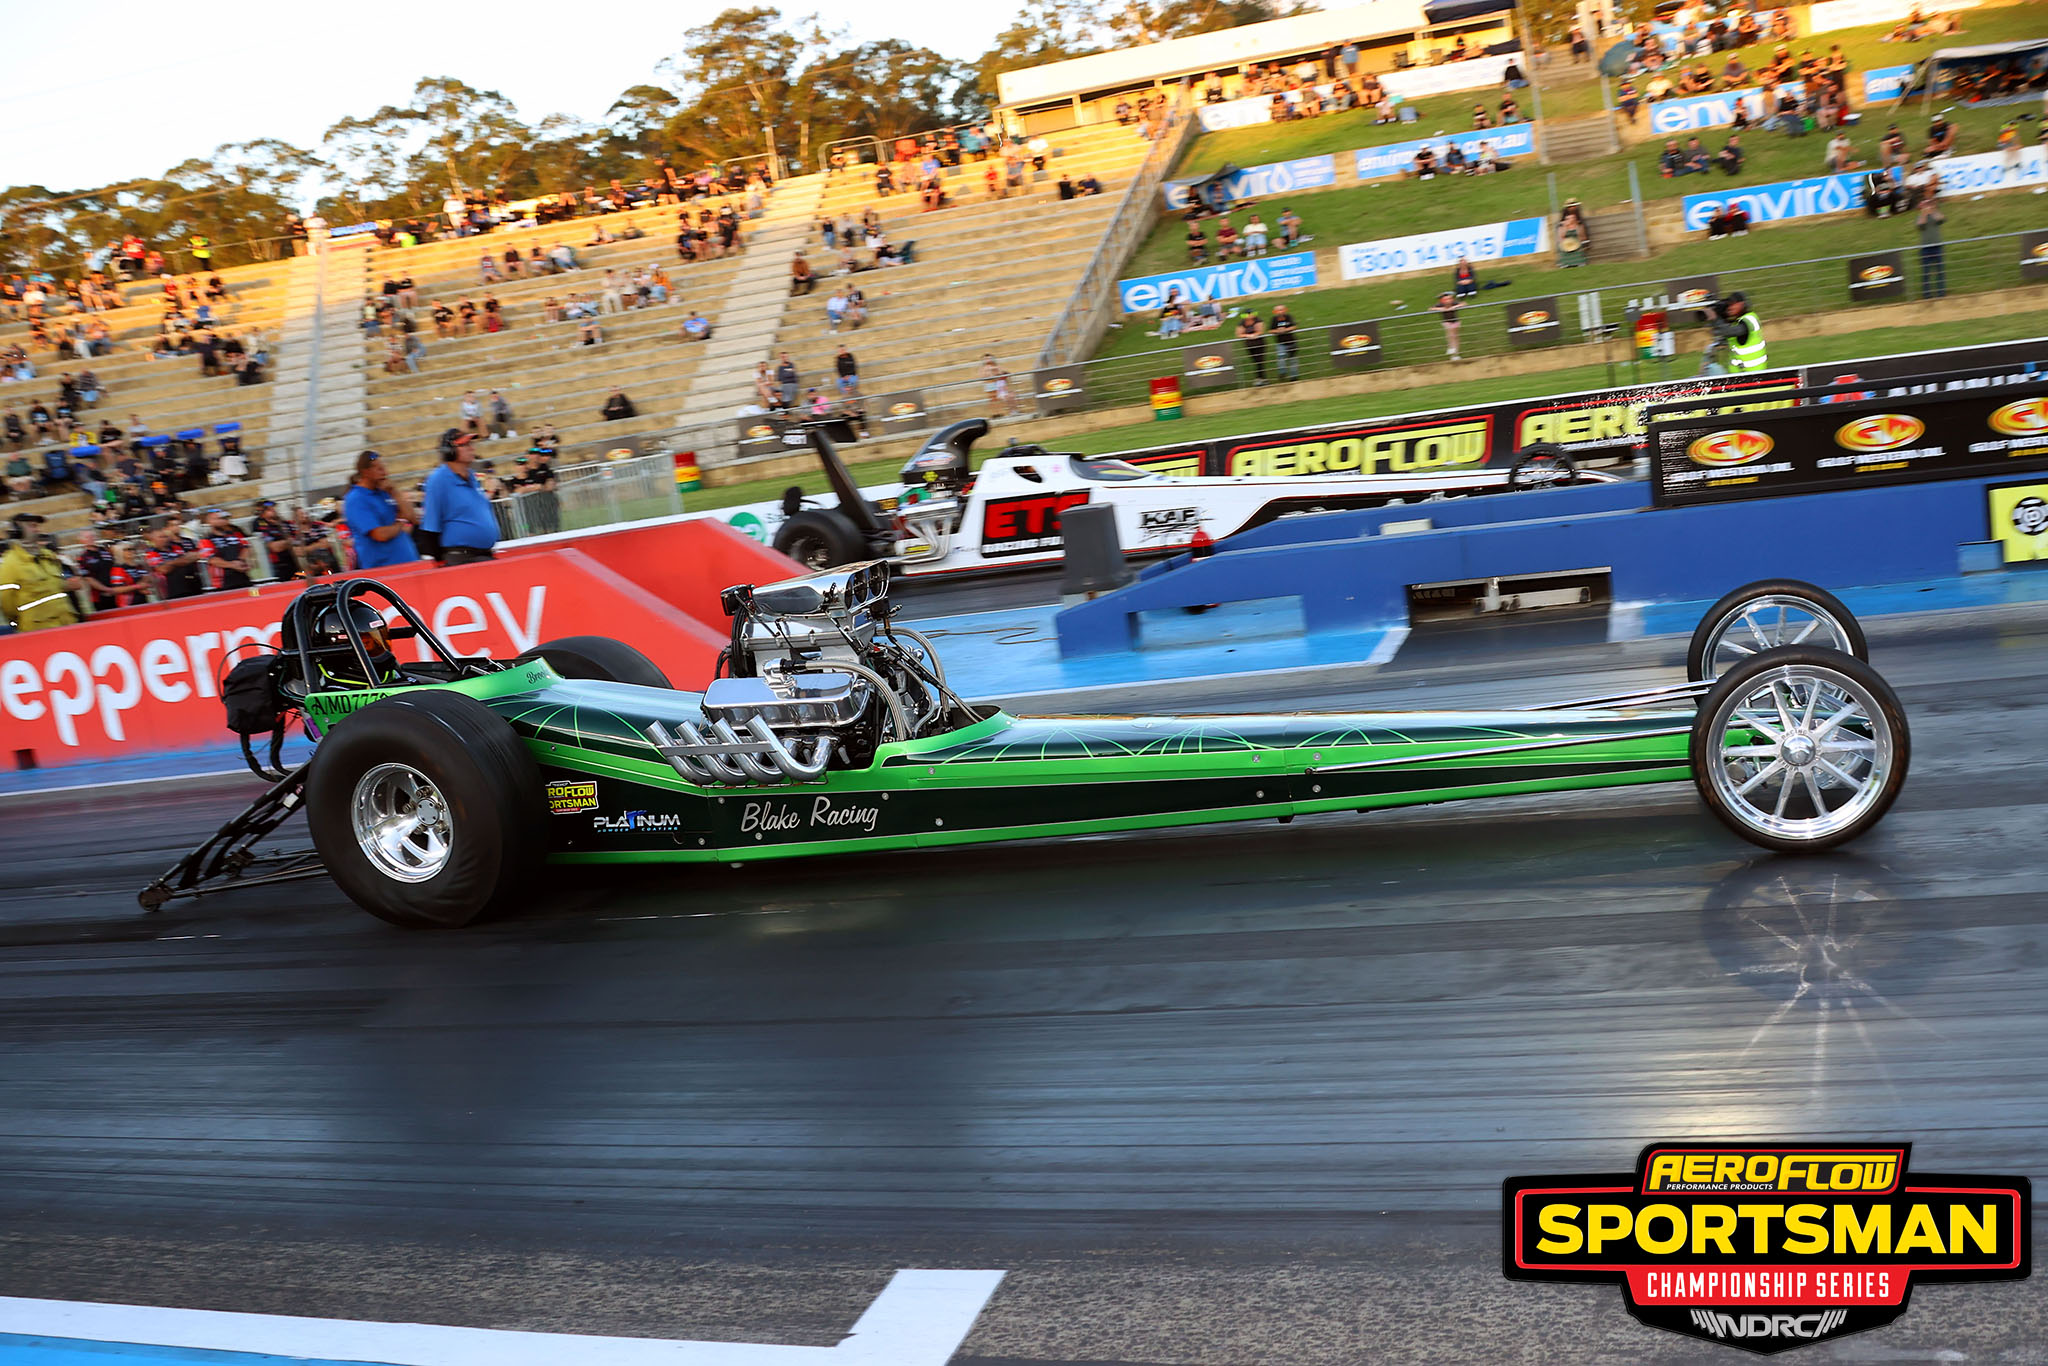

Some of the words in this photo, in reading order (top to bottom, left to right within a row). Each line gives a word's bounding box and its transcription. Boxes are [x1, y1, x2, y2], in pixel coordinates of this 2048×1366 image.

[1352, 250, 1408, 272] 1300
[1231, 422, 1487, 476] AEROFLOW
[547, 785, 594, 797] ROFLOW
[593, 810, 681, 829] PLATINUM
[741, 801, 800, 832] Blake
[810, 796, 879, 832] Racing
